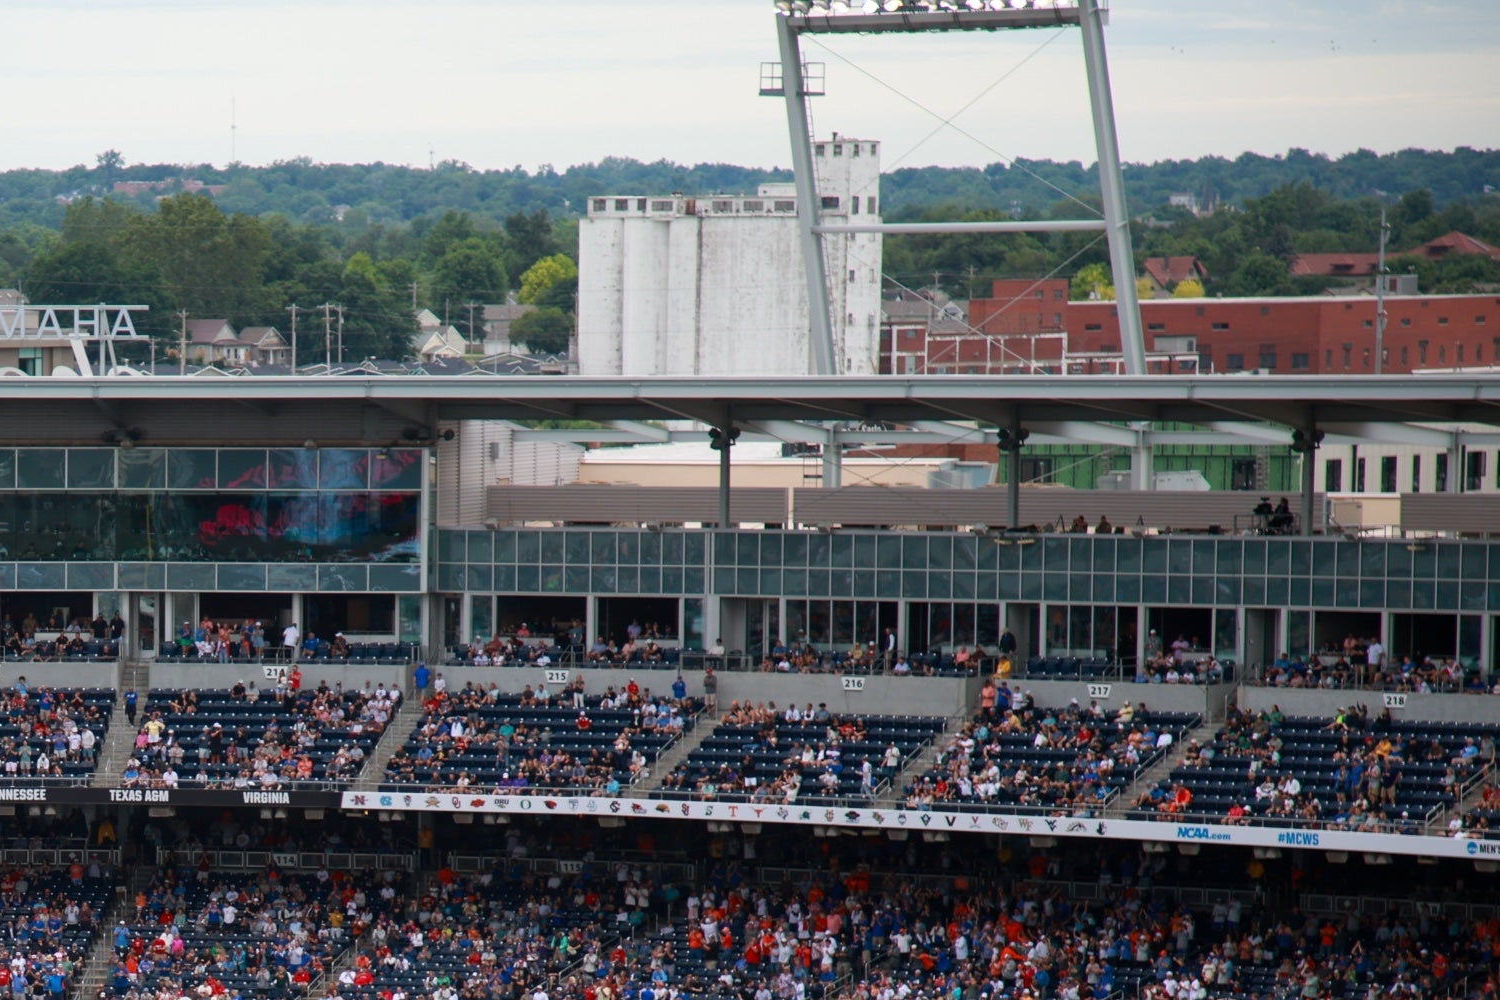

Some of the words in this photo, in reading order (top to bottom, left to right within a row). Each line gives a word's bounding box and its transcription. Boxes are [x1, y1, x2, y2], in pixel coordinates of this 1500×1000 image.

[548, 672, 566, 681] 215
[845, 679, 863, 688] 216
[1091, 686, 1109, 695] 217
[1386, 696, 1405, 705] 218
[109, 789, 143, 802] TEXAS
[144, 790, 169, 802] A&M
[243, 791, 290, 804] VIRGINIA
[1177, 826, 1231, 841] NCAA.com
[1278, 832, 1319, 846] #MCWS
[277, 856, 294, 864] 114
